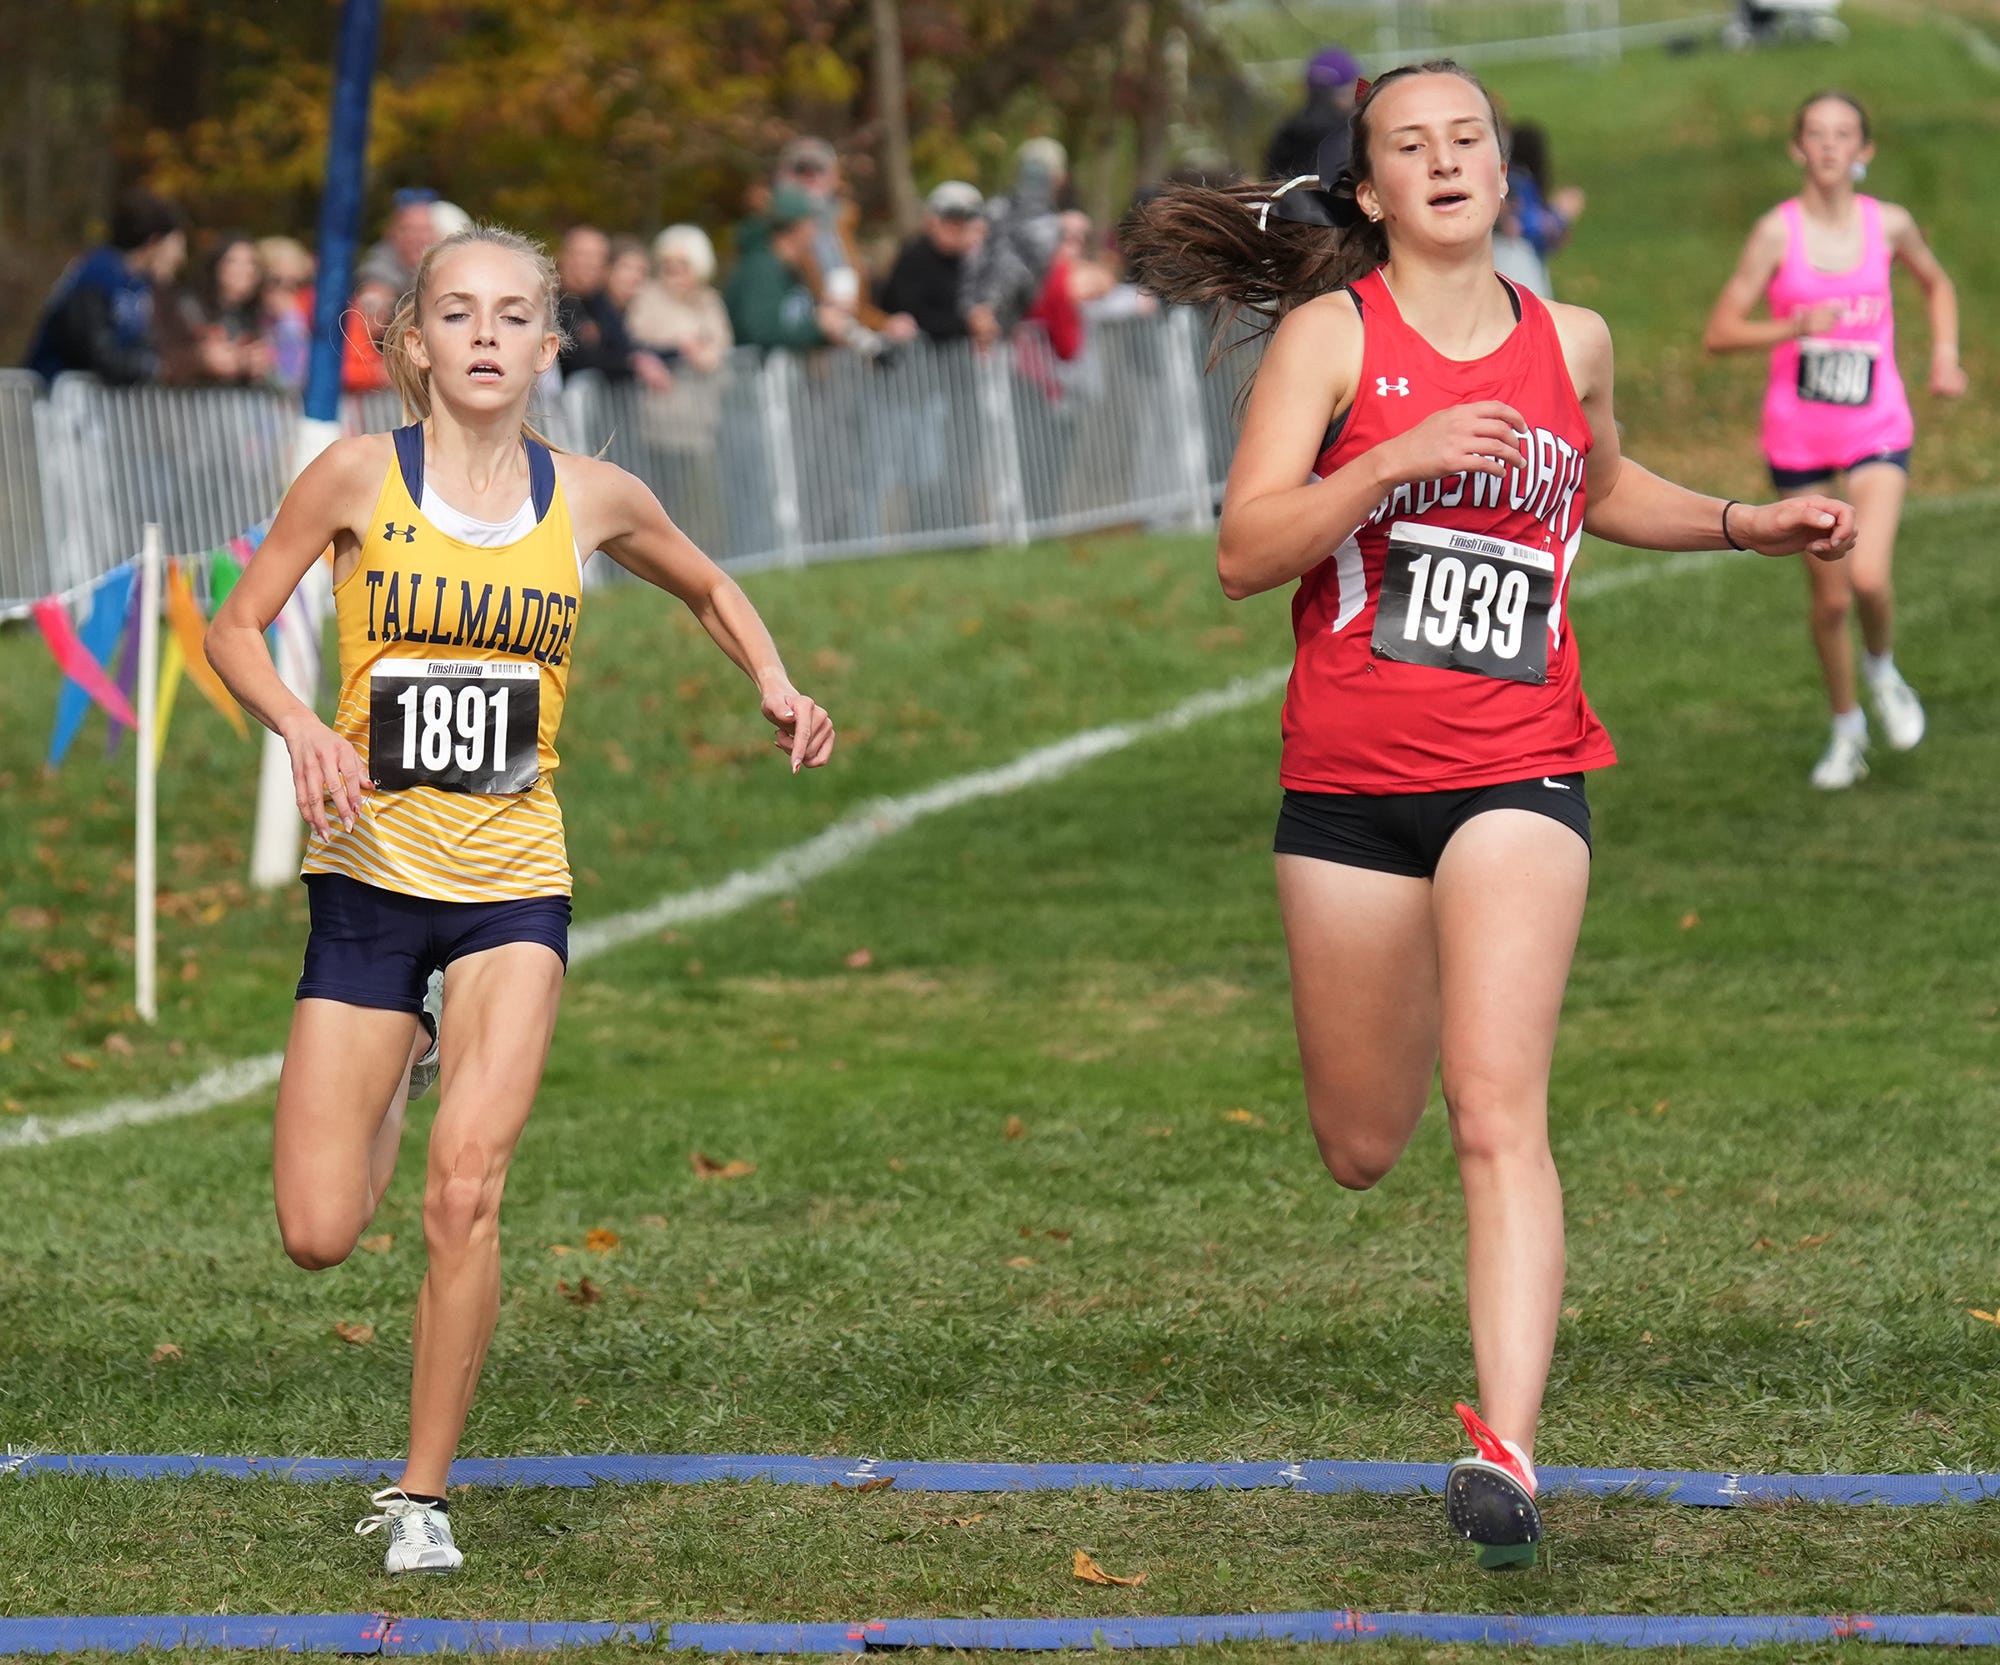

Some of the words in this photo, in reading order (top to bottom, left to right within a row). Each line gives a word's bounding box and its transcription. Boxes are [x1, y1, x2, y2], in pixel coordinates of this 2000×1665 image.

[1366, 426, 1585, 543] SWORTH
[366, 570, 577, 666] TALLMADGE
[1403, 553, 1530, 660] 1939
[397, 684, 510, 772] 1891
